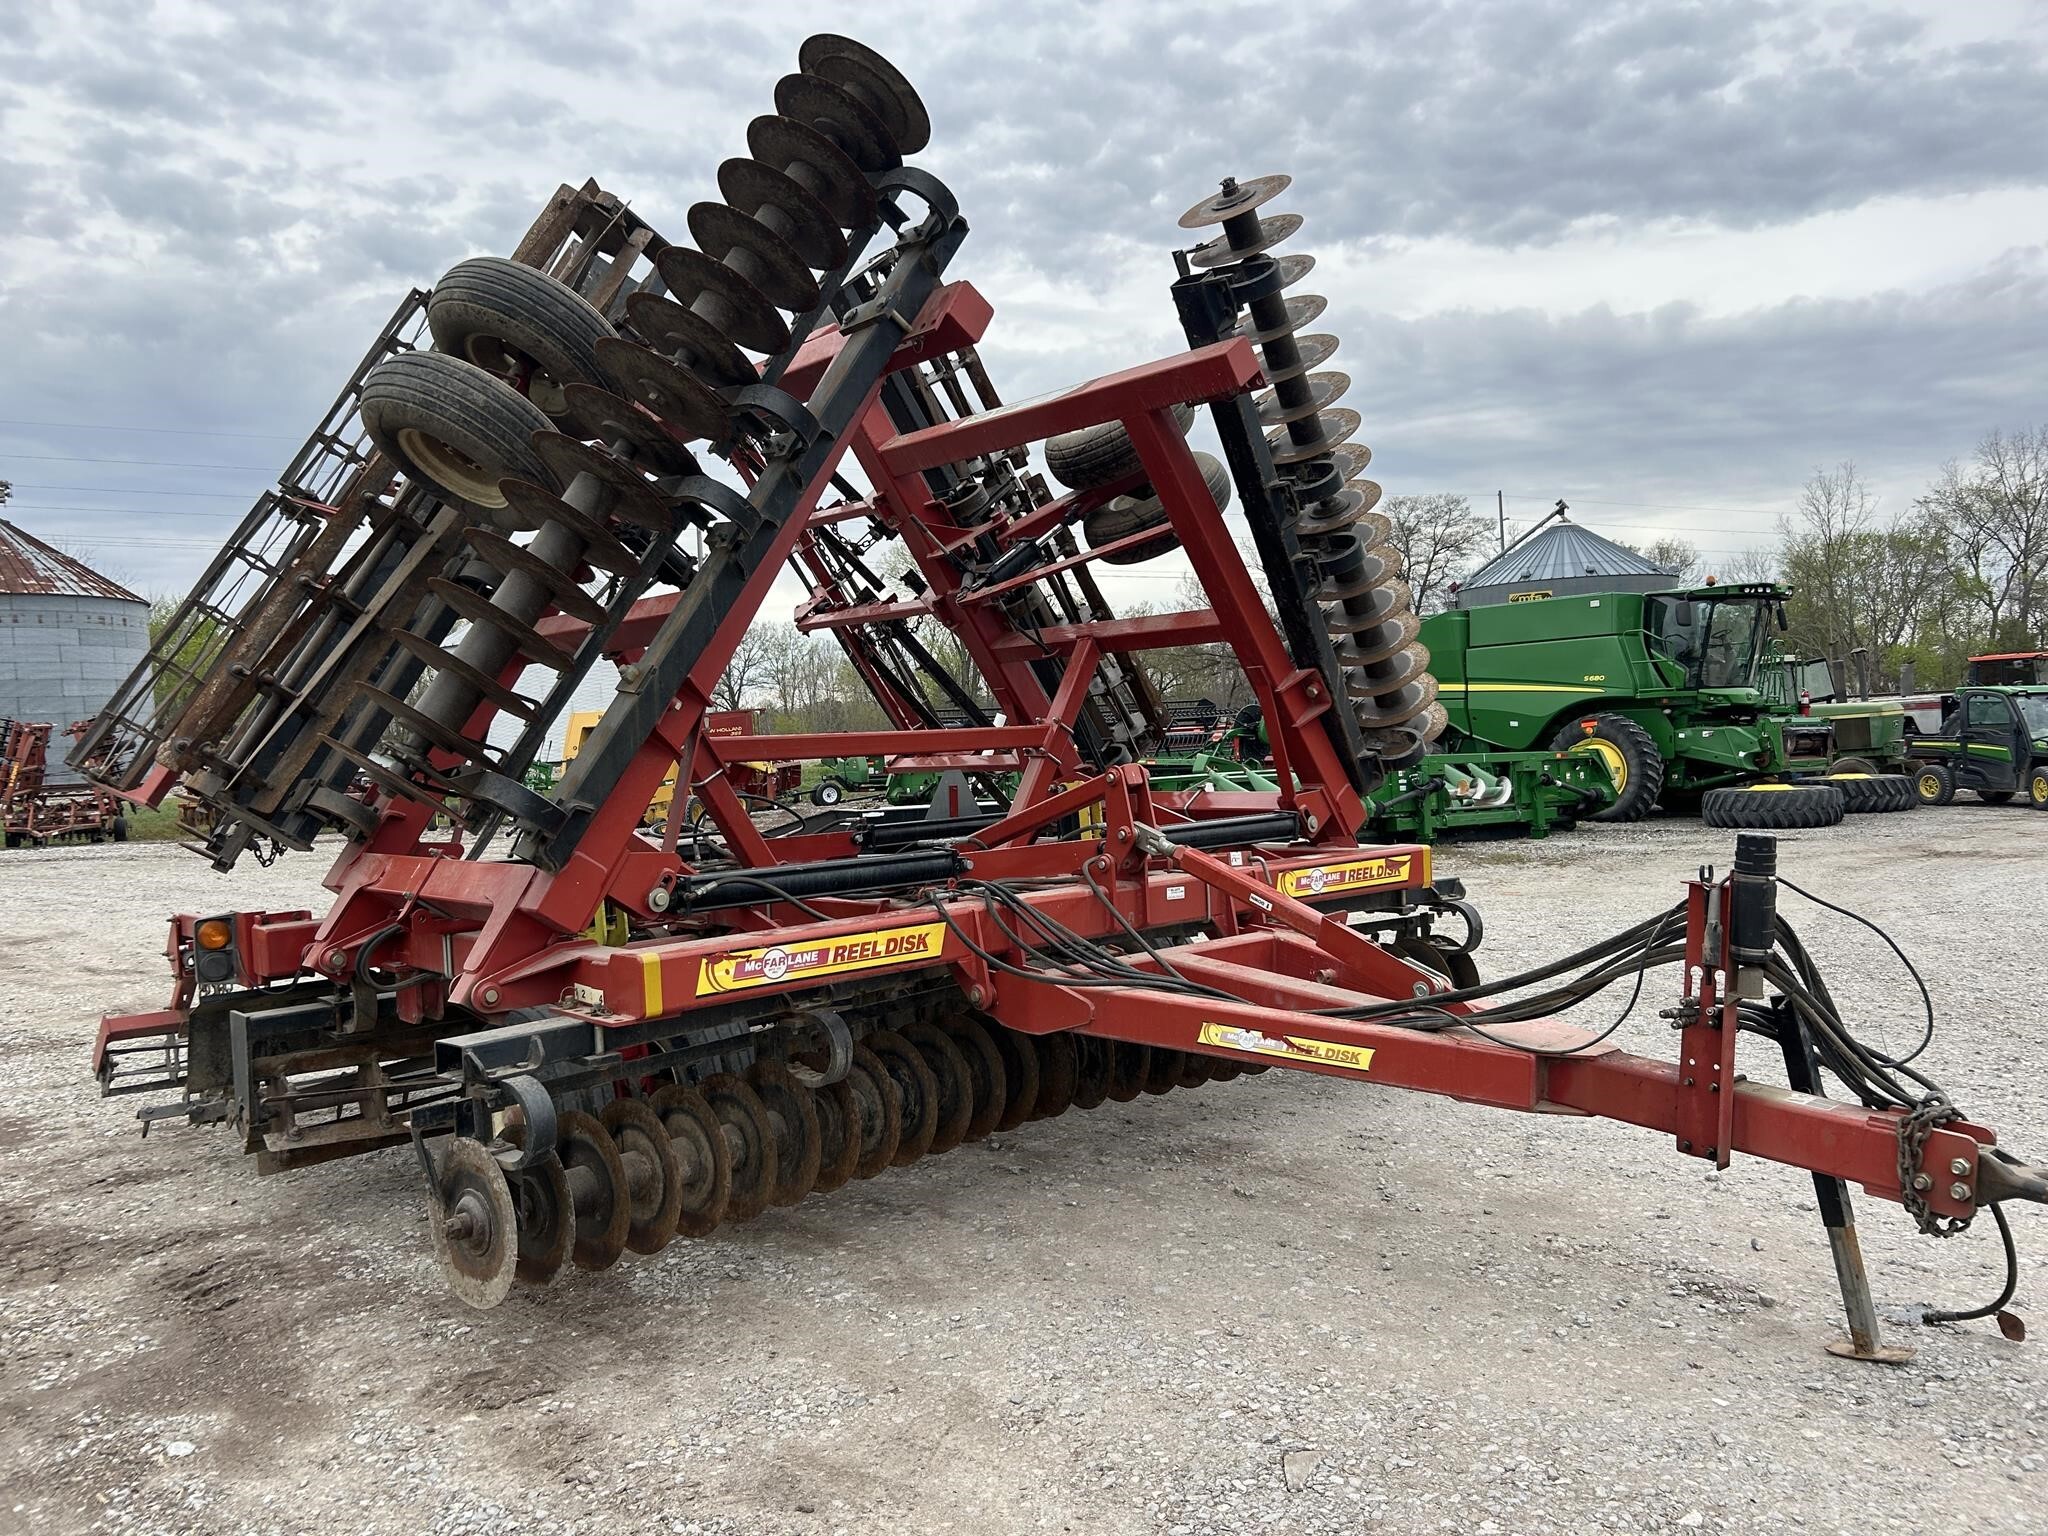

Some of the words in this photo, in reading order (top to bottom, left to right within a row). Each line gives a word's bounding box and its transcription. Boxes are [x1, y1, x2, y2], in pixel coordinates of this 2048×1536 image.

[1348, 866, 1375, 881] REEL
[832, 940, 881, 963] REEL
[885, 932, 930, 955] DISK
[1325, 1048, 1362, 1062] DISK
